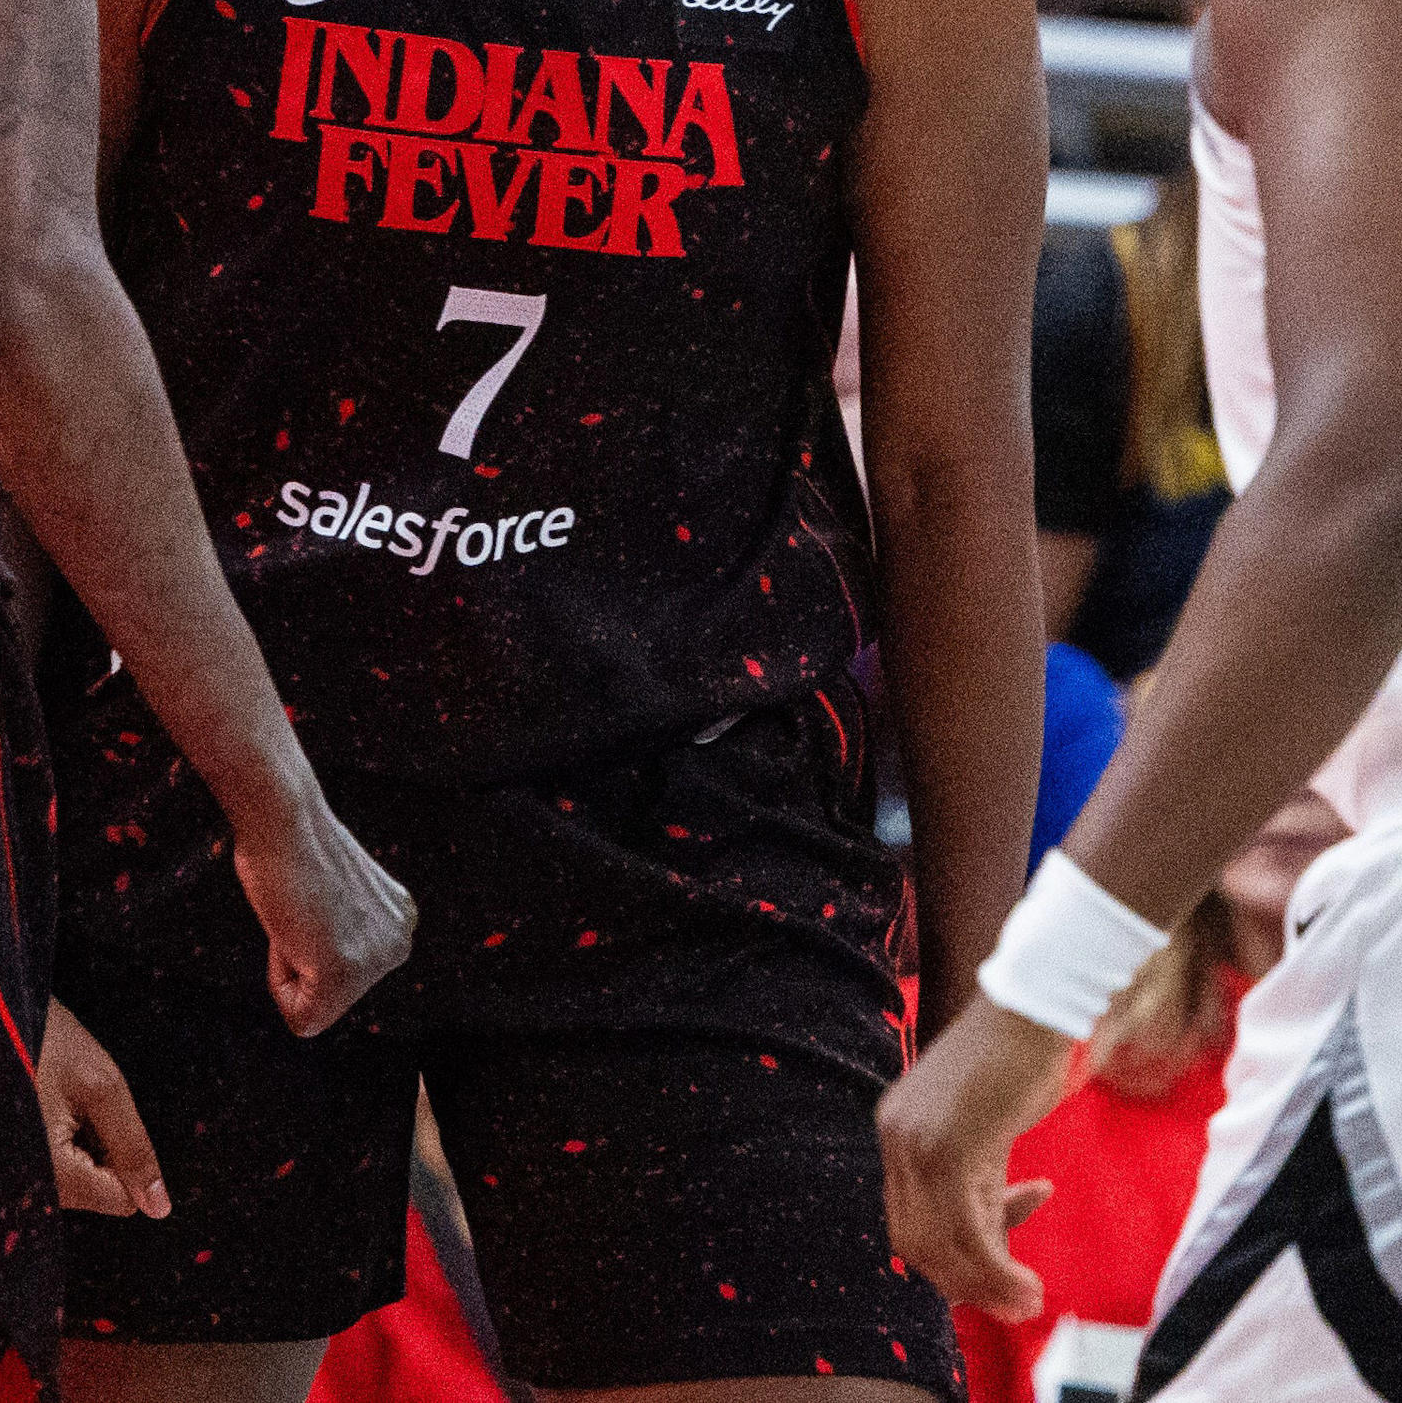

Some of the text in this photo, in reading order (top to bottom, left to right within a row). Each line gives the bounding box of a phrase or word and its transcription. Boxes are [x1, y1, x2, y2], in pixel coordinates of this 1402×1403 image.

[269, 16, 745, 187] INDIANA
[309, 124, 686, 258] FEVER
[436, 285, 547, 460] 7
[276, 481, 575, 576] salesforce
